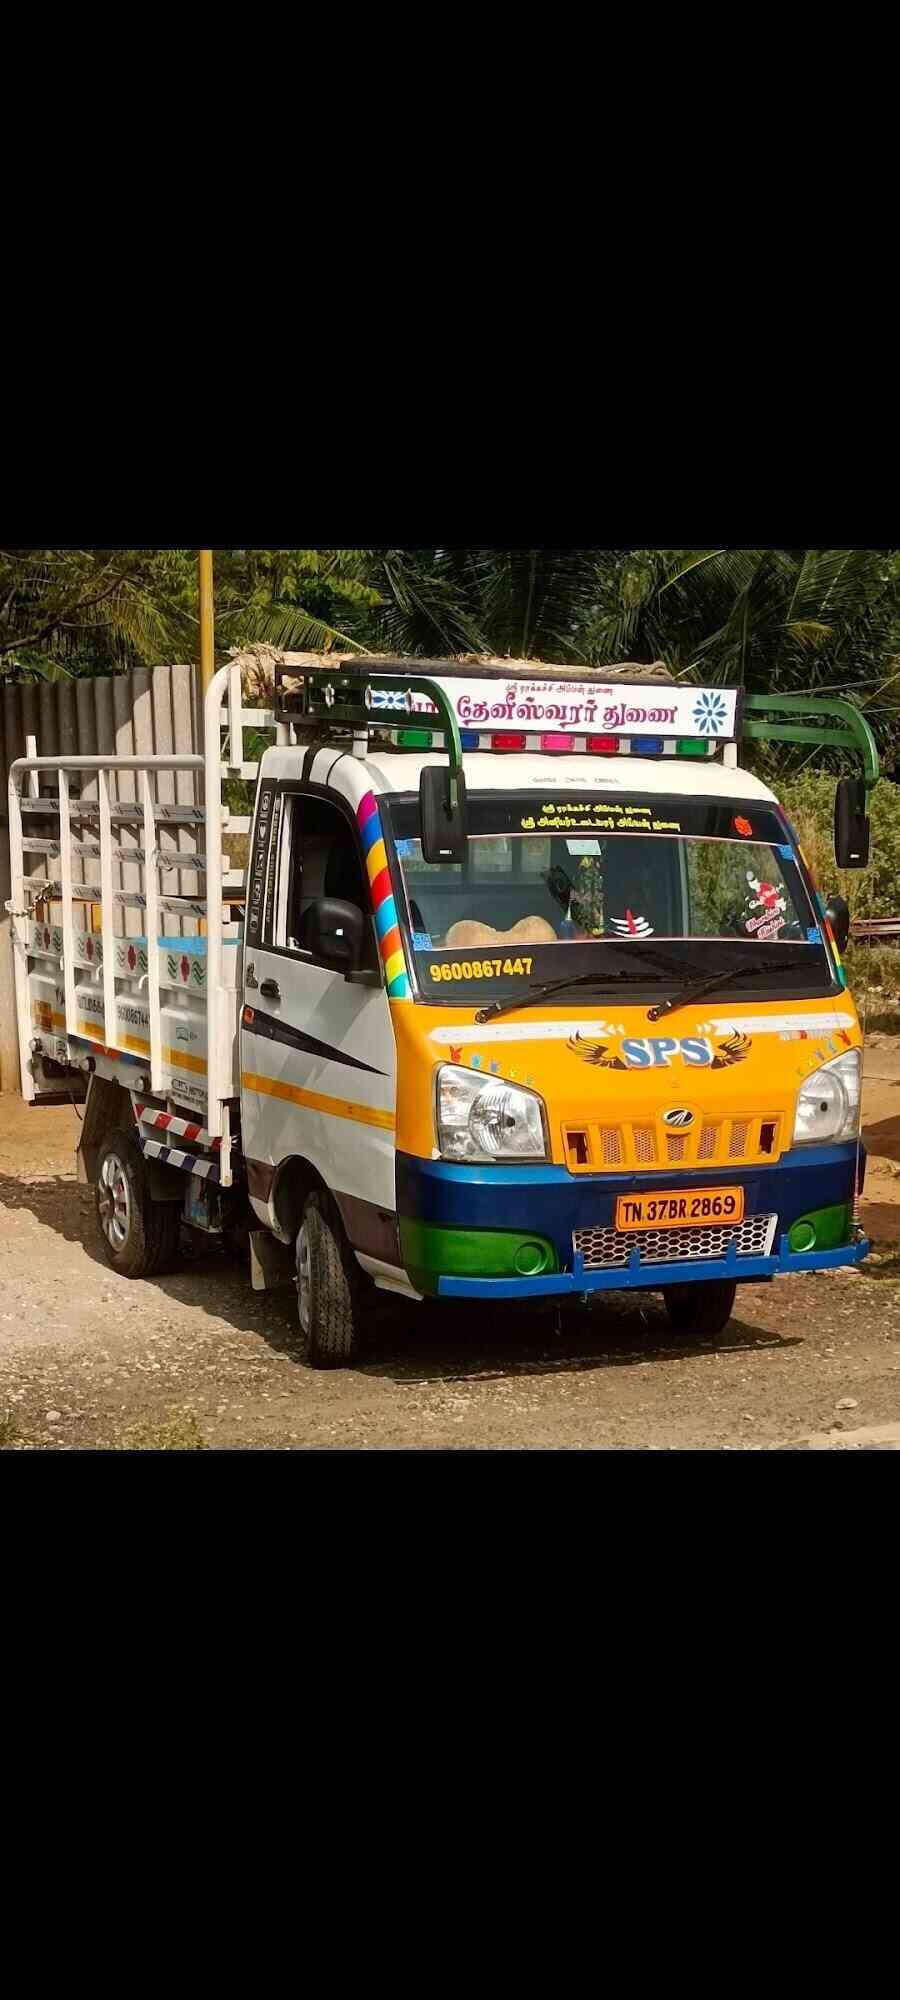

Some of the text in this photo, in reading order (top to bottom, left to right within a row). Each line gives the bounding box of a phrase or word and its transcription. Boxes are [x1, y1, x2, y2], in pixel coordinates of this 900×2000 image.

[457, 691, 598, 727] தேனீஸ்வரர்
[602, 703, 678, 729] துணை
[429, 957, 533, 982] 9600867447
[621, 1036, 714, 1069] SPS
[690, 1195, 736, 1218] 2869
